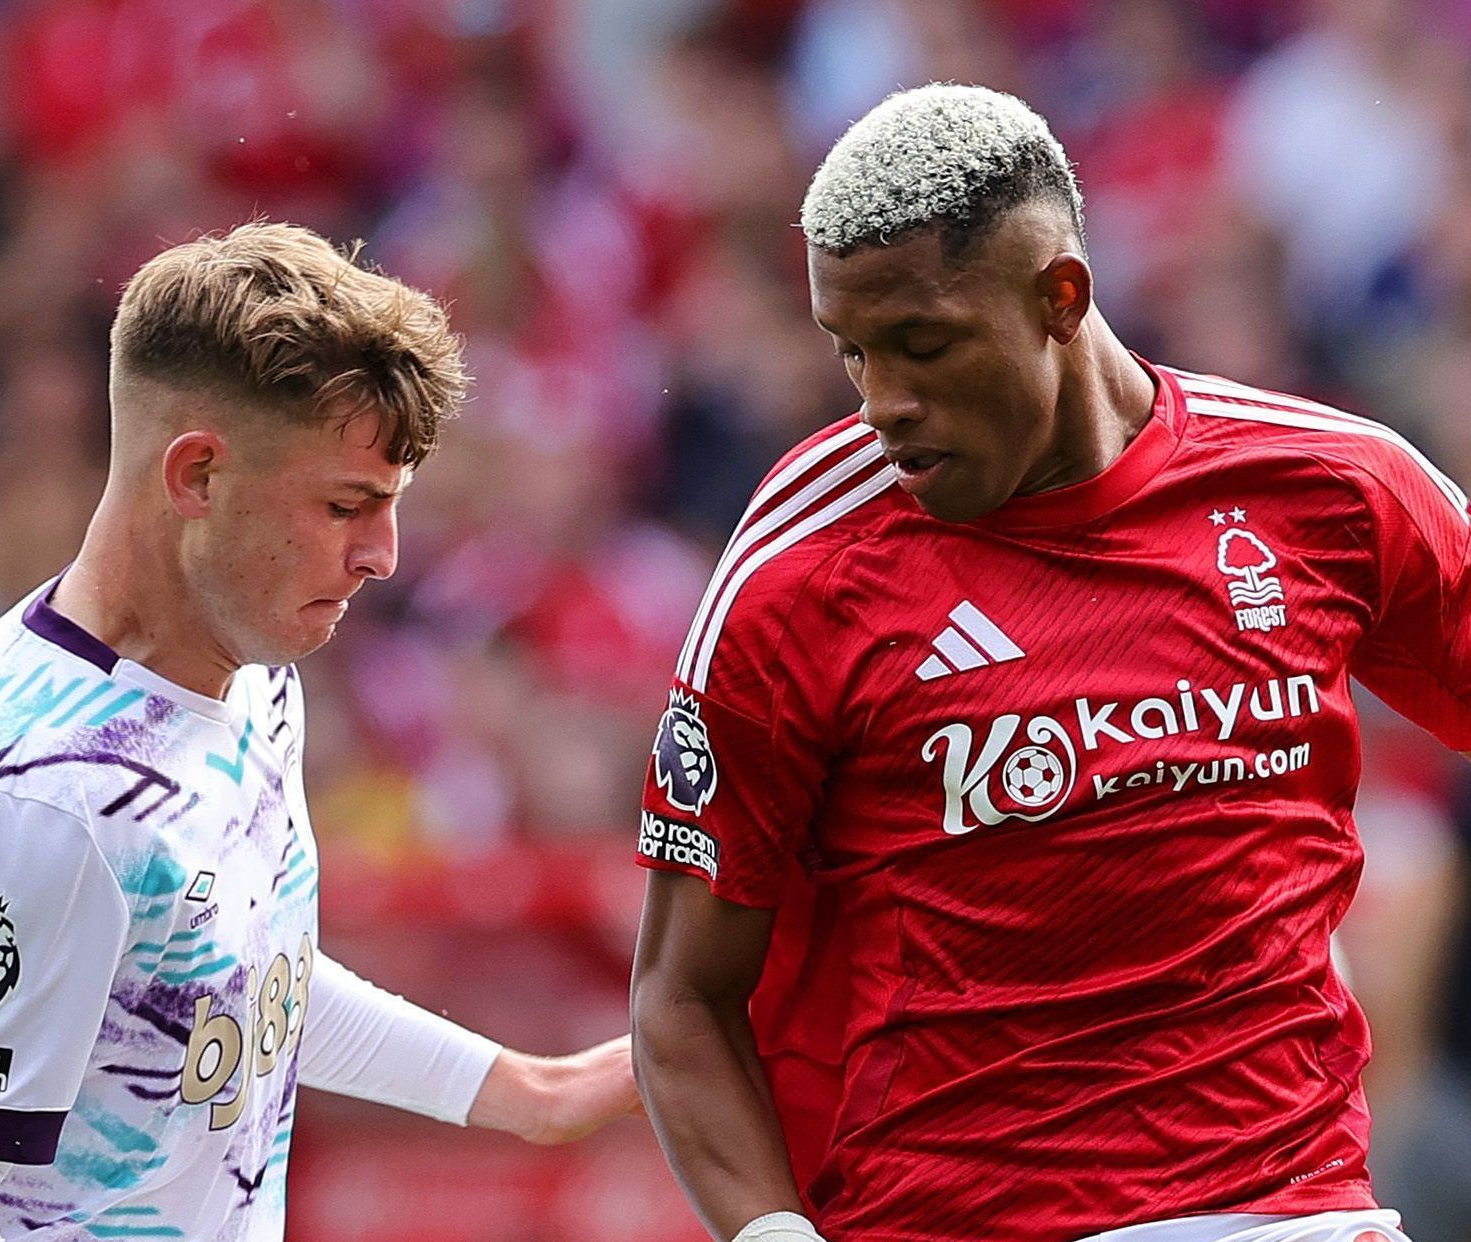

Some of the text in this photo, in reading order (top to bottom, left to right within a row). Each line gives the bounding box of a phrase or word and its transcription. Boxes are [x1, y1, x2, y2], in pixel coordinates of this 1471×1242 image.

[1074, 673, 1322, 751] kaiyun
[1091, 741, 1311, 800] kaiyun.com
[637, 831, 718, 880] for racism
[640, 809, 716, 859] No room
